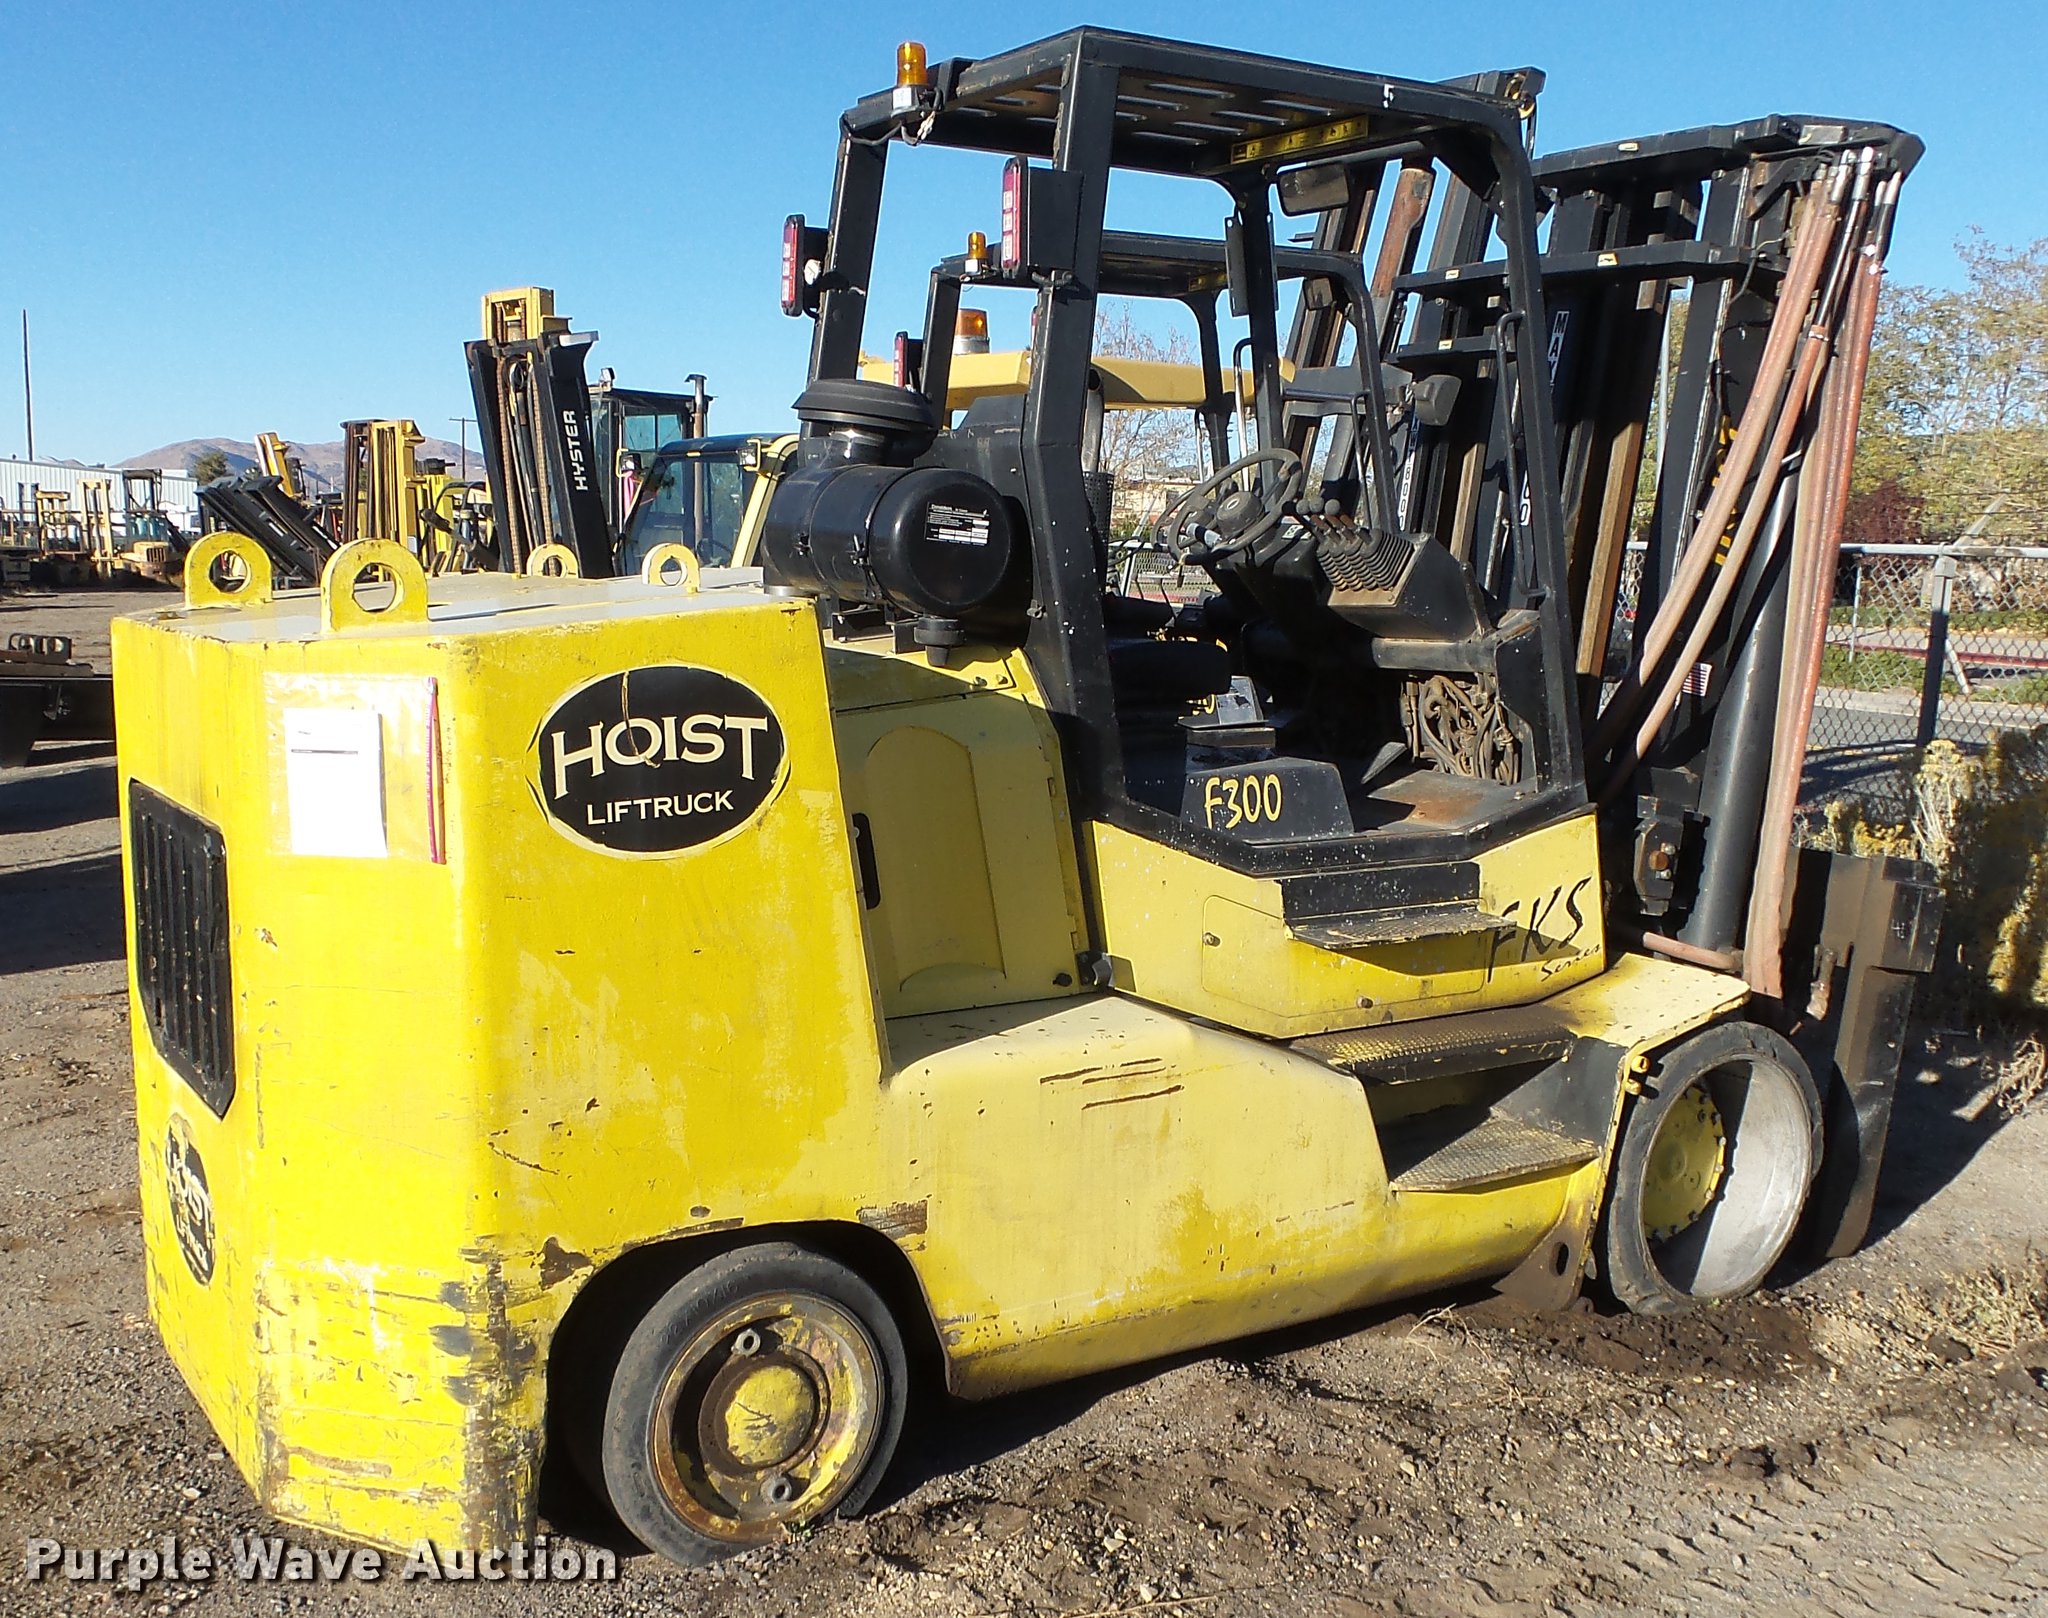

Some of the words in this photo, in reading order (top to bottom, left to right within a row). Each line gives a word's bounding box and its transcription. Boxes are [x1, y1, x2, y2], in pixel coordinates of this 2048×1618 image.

[563, 410, 589, 491] HYSTER
[551, 713, 768, 800] HOIST
[586, 790, 734, 826] LIFTRUCK
[1204, 773, 1282, 830] F300
